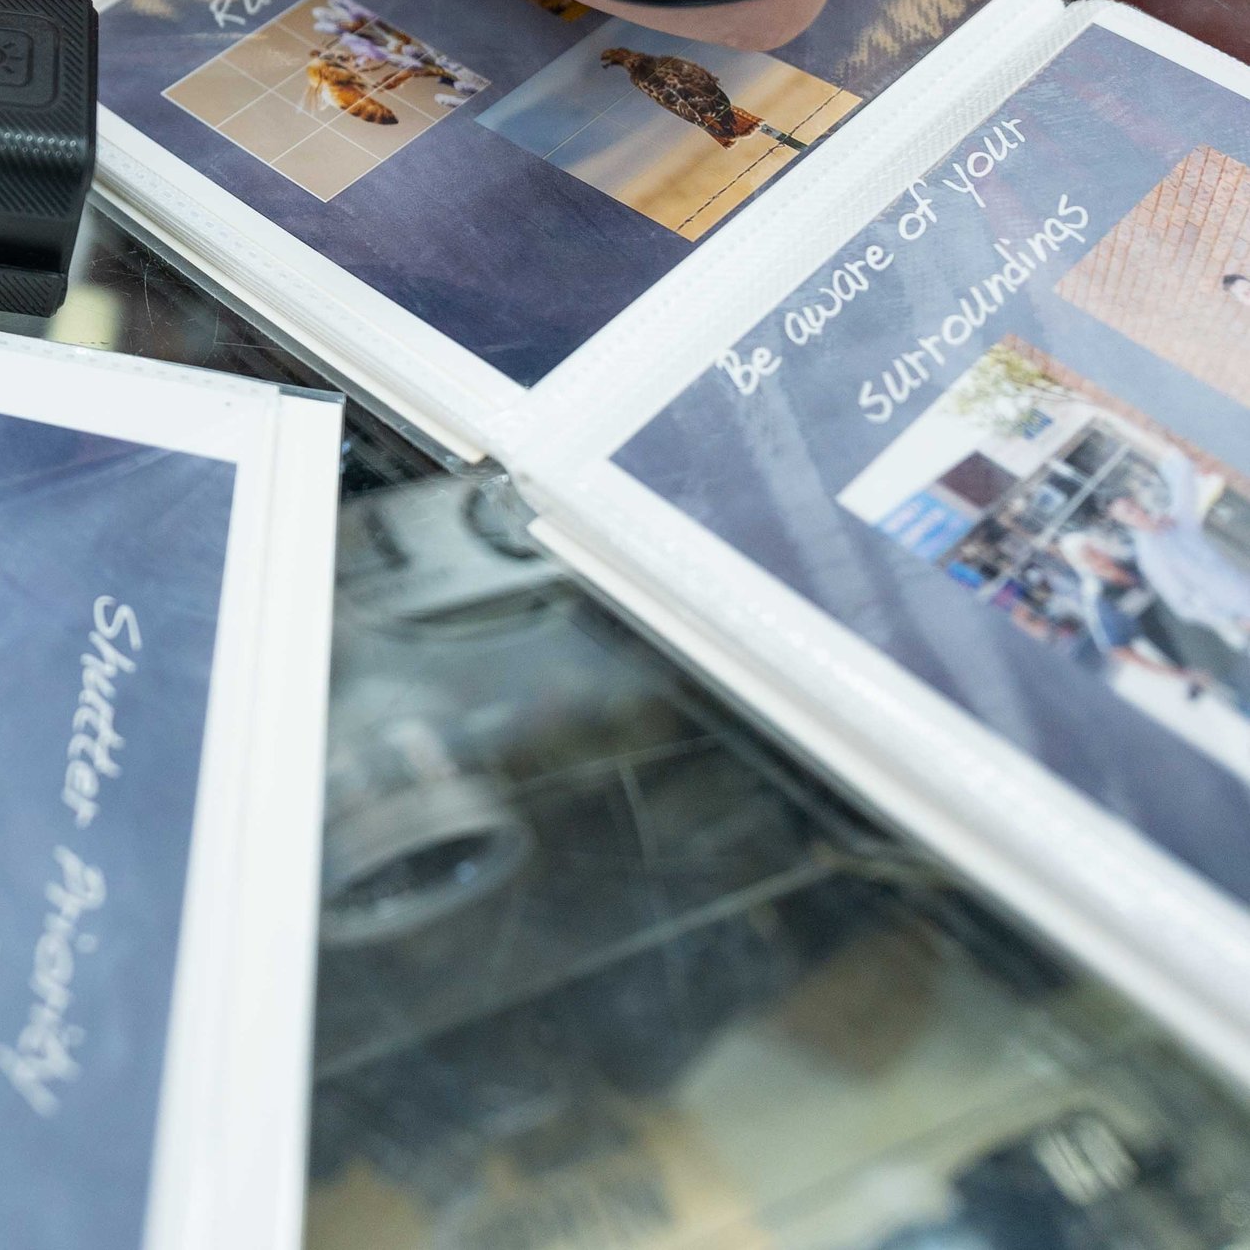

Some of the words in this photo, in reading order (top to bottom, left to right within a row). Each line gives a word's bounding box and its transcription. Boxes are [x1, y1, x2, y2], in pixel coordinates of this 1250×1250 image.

[716, 347, 782, 395] Be
[784, 244, 894, 345] aware
[898, 179, 937, 240] of
[942, 118, 1026, 208] your
[858, 194, 1089, 424] surroundings
[61, 594, 143, 829] Shutter
